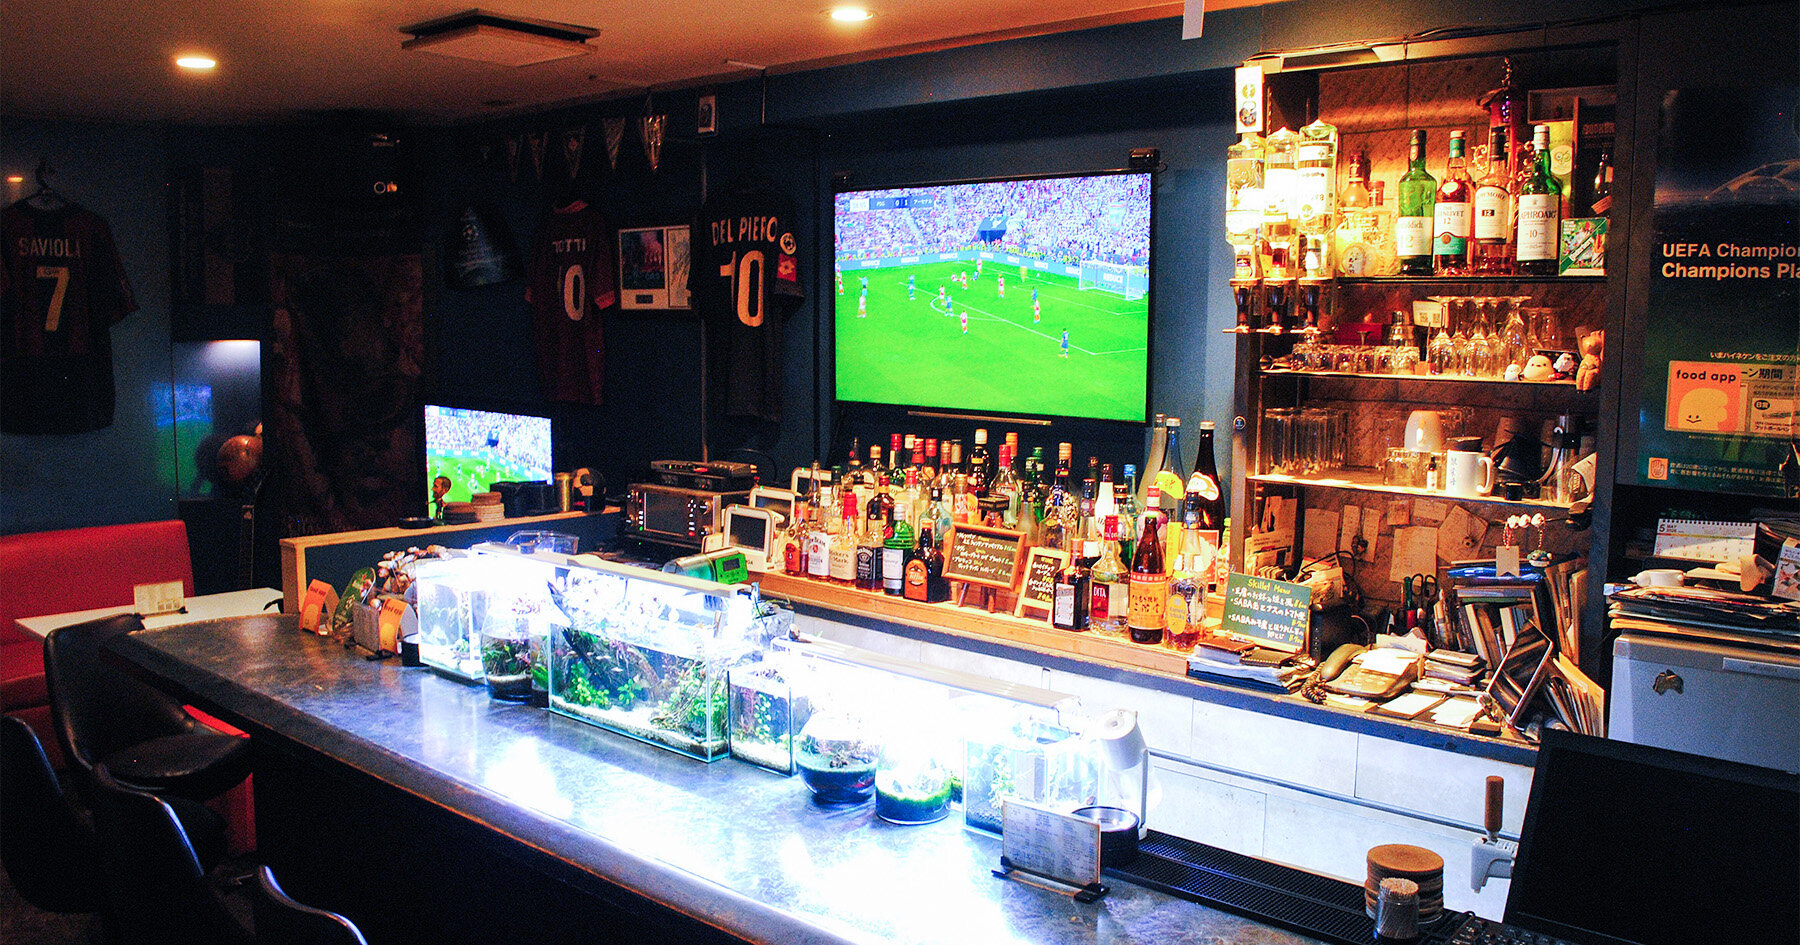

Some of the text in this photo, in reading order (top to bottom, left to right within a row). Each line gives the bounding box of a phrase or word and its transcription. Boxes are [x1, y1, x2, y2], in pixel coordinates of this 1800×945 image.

[711, 218, 734, 247] DEL
[1662, 243, 1712, 258] UEFA
[1661, 261, 1772, 281] Champions
[720, 250, 765, 327] 10
[36, 265, 70, 332] 7
[1676, 369, 1736, 383] food app
[1659, 524, 1666, 532] 5
[1093, 586, 1107, 598] DITA
